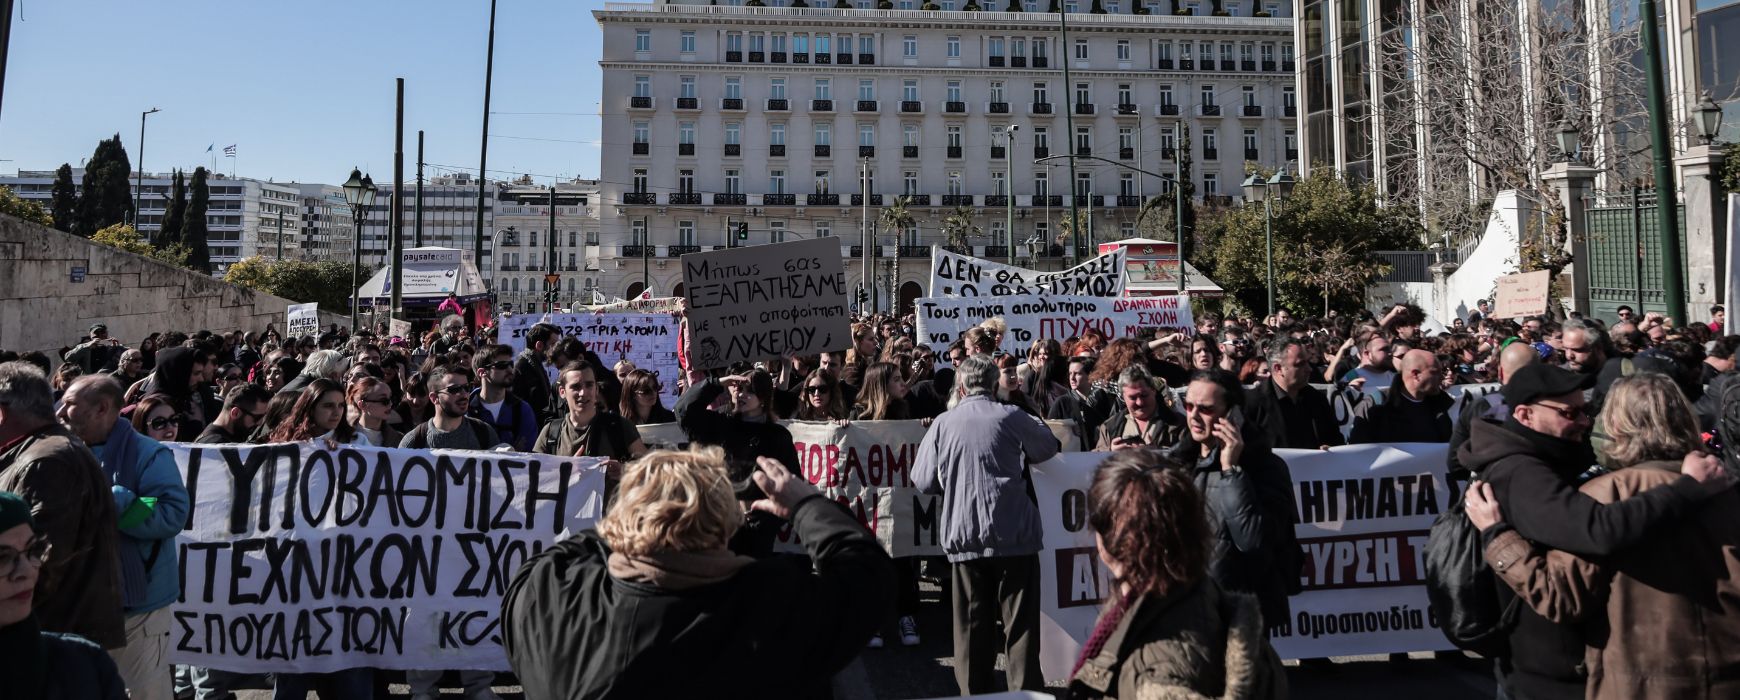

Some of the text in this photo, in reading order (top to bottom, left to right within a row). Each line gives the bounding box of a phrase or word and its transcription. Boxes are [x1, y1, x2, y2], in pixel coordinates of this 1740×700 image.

[403, 252, 453, 262] paysafecard
[687, 257, 822, 283] Μήπως σας
[937, 256, 982, 284] ΔΕΝ
[995, 269, 1025, 284] ΘΑ
[688, 272, 847, 309] ΕΞΑΠΑΤΗΣΑΜΕ
[1698, 282, 1706, 295] 3
[922, 297, 1097, 320] Τους πήγα απολυτήριο
[1113, 298, 1179, 313] ΔΡΑΜΑΤΙΚΗ
[1137, 311, 1178, 325] ΣΧΟΛΗ
[289, 316, 317, 327] ΑΜΕΣΗ
[587, 325, 620, 336] ΤΡΙΑ
[624, 325, 668, 336] ΧΡΟΝΙΑ
[693, 303, 845, 338] με την αποφοίτηση
[929, 332, 950, 344] να
[795, 441, 919, 488] ΠΟΒΑΘΜΙ
[220, 443, 573, 534] ΥΠΟΒΑΘΜΙΣΗ
[1293, 473, 1439, 525] ΗΓΜΑΤΑ
[178, 532, 542, 605] ΙΤΕΧΝΙΚΩΝ ΣΧΟ
[173, 605, 408, 661] ΣΠΟΥΔΑΣΤΩΝ
[1297, 603, 1424, 639] Ομοσπονδία
